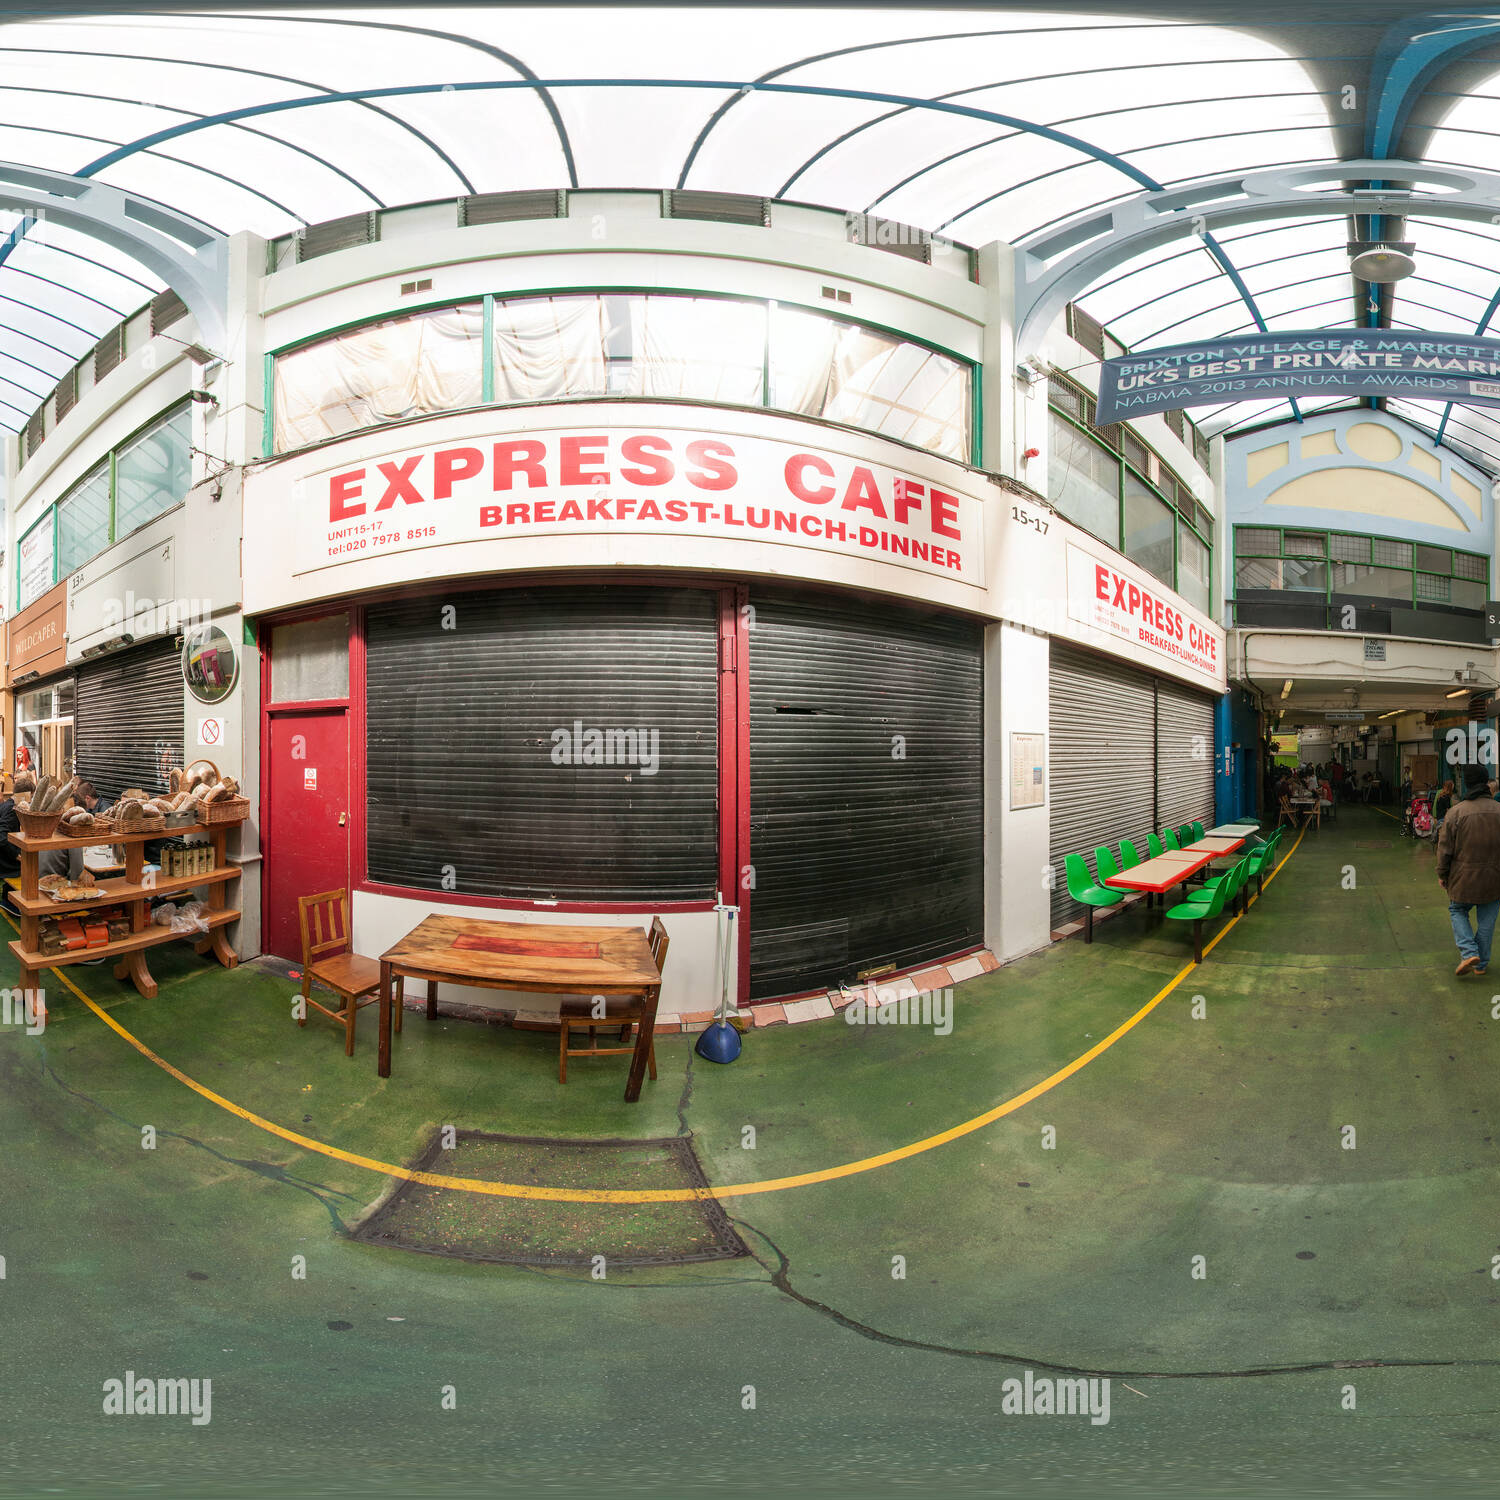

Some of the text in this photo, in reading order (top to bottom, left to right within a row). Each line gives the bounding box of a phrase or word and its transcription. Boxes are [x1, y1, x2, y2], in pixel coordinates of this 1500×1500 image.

[1117, 369, 1180, 392] UK'S
[1188, 356, 1265, 380] BEST
[1273, 352, 1403, 369] PRIVATE
[1119, 348, 1224, 377] BRIXTON
[1232, 340, 1342, 356] VILLAGE
[1352, 339, 1369, 350] &
[1376, 340, 1486, 359] MARKET
[1114, 374, 1459, 411] NABMA 2013 ANNUAL AWARDS
[330, 435, 962, 541] EXPRESS CAFE
[328, 521, 383, 541] UNIT15-17
[480, 498, 962, 571] BREAKFAST-LUNCH-DINNER
[1011, 506, 1050, 536] 15-17
[328, 525, 436, 556] tel:020 7978 8515
[1095, 563, 1217, 661] EXPRESS CAFE
[15, 621, 57, 656] WILDCAPER
